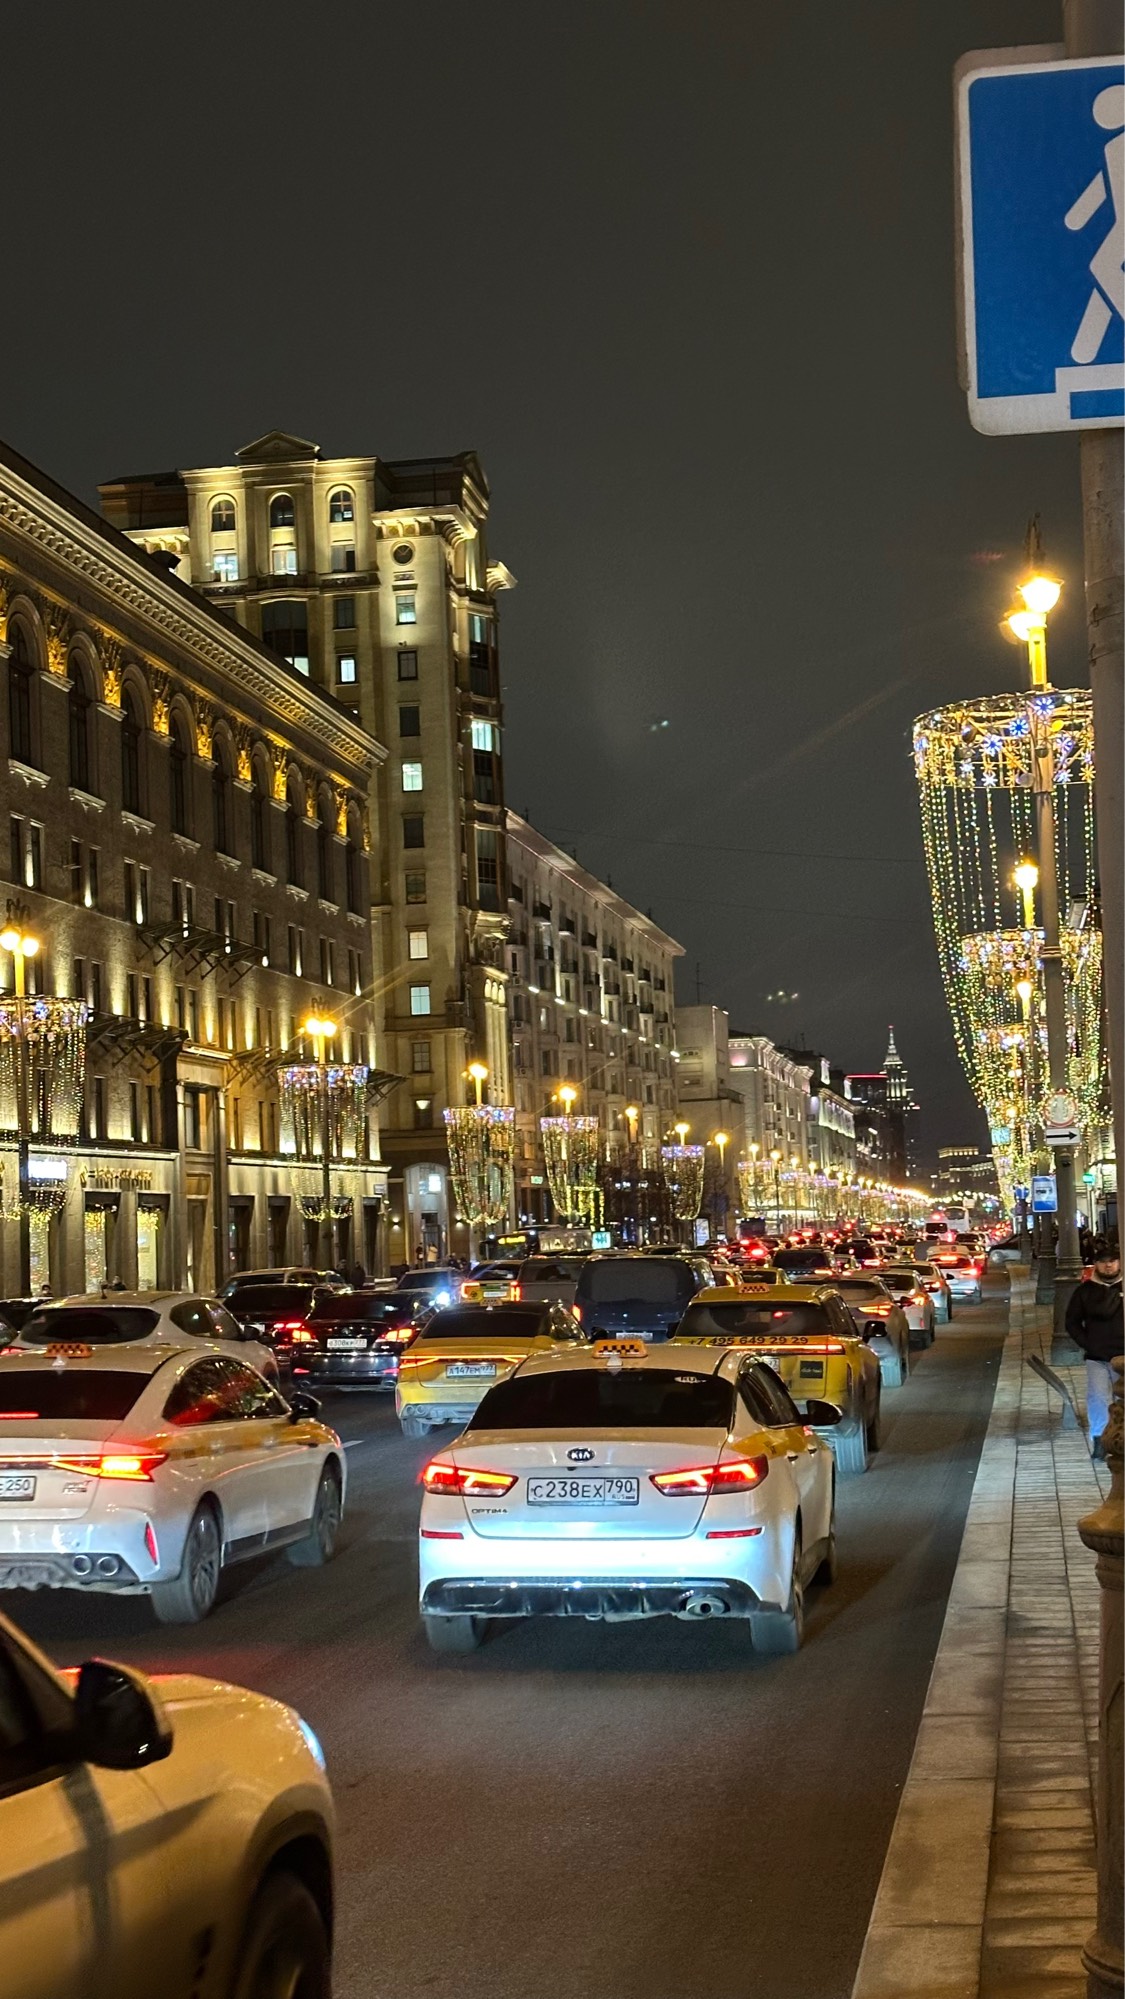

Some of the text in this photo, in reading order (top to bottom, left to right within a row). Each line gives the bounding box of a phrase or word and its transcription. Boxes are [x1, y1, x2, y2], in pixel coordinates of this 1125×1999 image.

[709, 1336, 735, 1345] 495
[739, 1336, 765, 1344] 649
[770, 1336, 787, 1344] 29
[790, 1336, 808, 1344] 29
[570, 1450, 591, 1461] KIA
[6, 1479, 31, 1491] 250
[605, 1479, 634, 1494] 790
